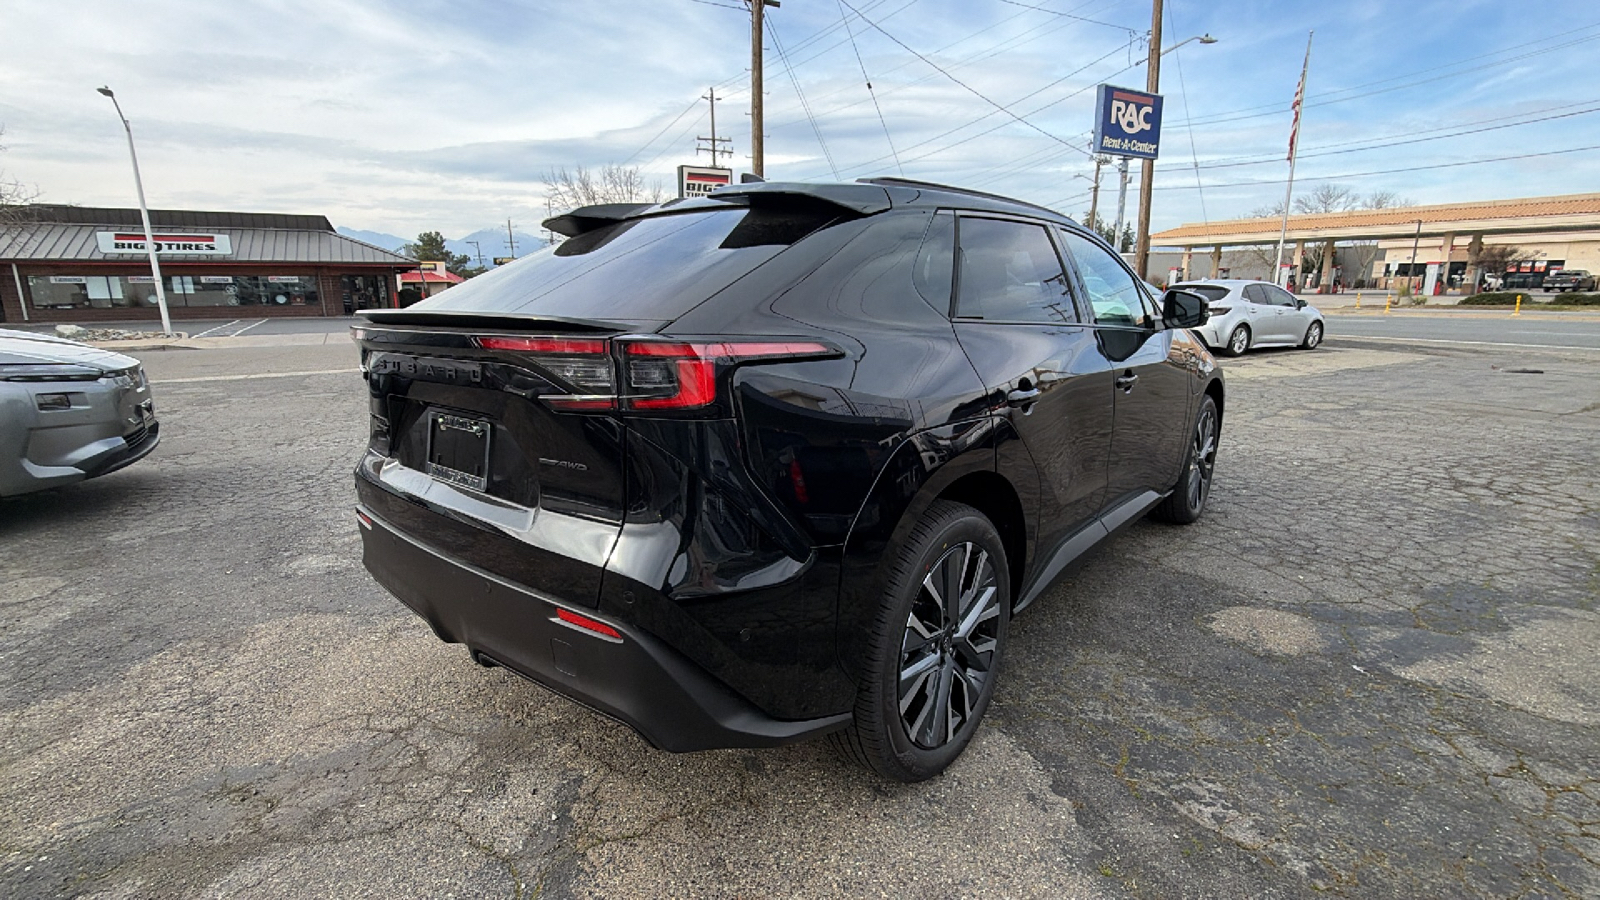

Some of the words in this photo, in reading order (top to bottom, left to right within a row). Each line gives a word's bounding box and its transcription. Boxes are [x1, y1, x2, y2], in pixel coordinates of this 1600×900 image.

[1110, 100, 1153, 134] RAC
[686, 182, 713, 192] BIG
[114, 242, 146, 250] BIG
[165, 242, 216, 251] TIRES
[379, 359, 482, 383] SUBARU
